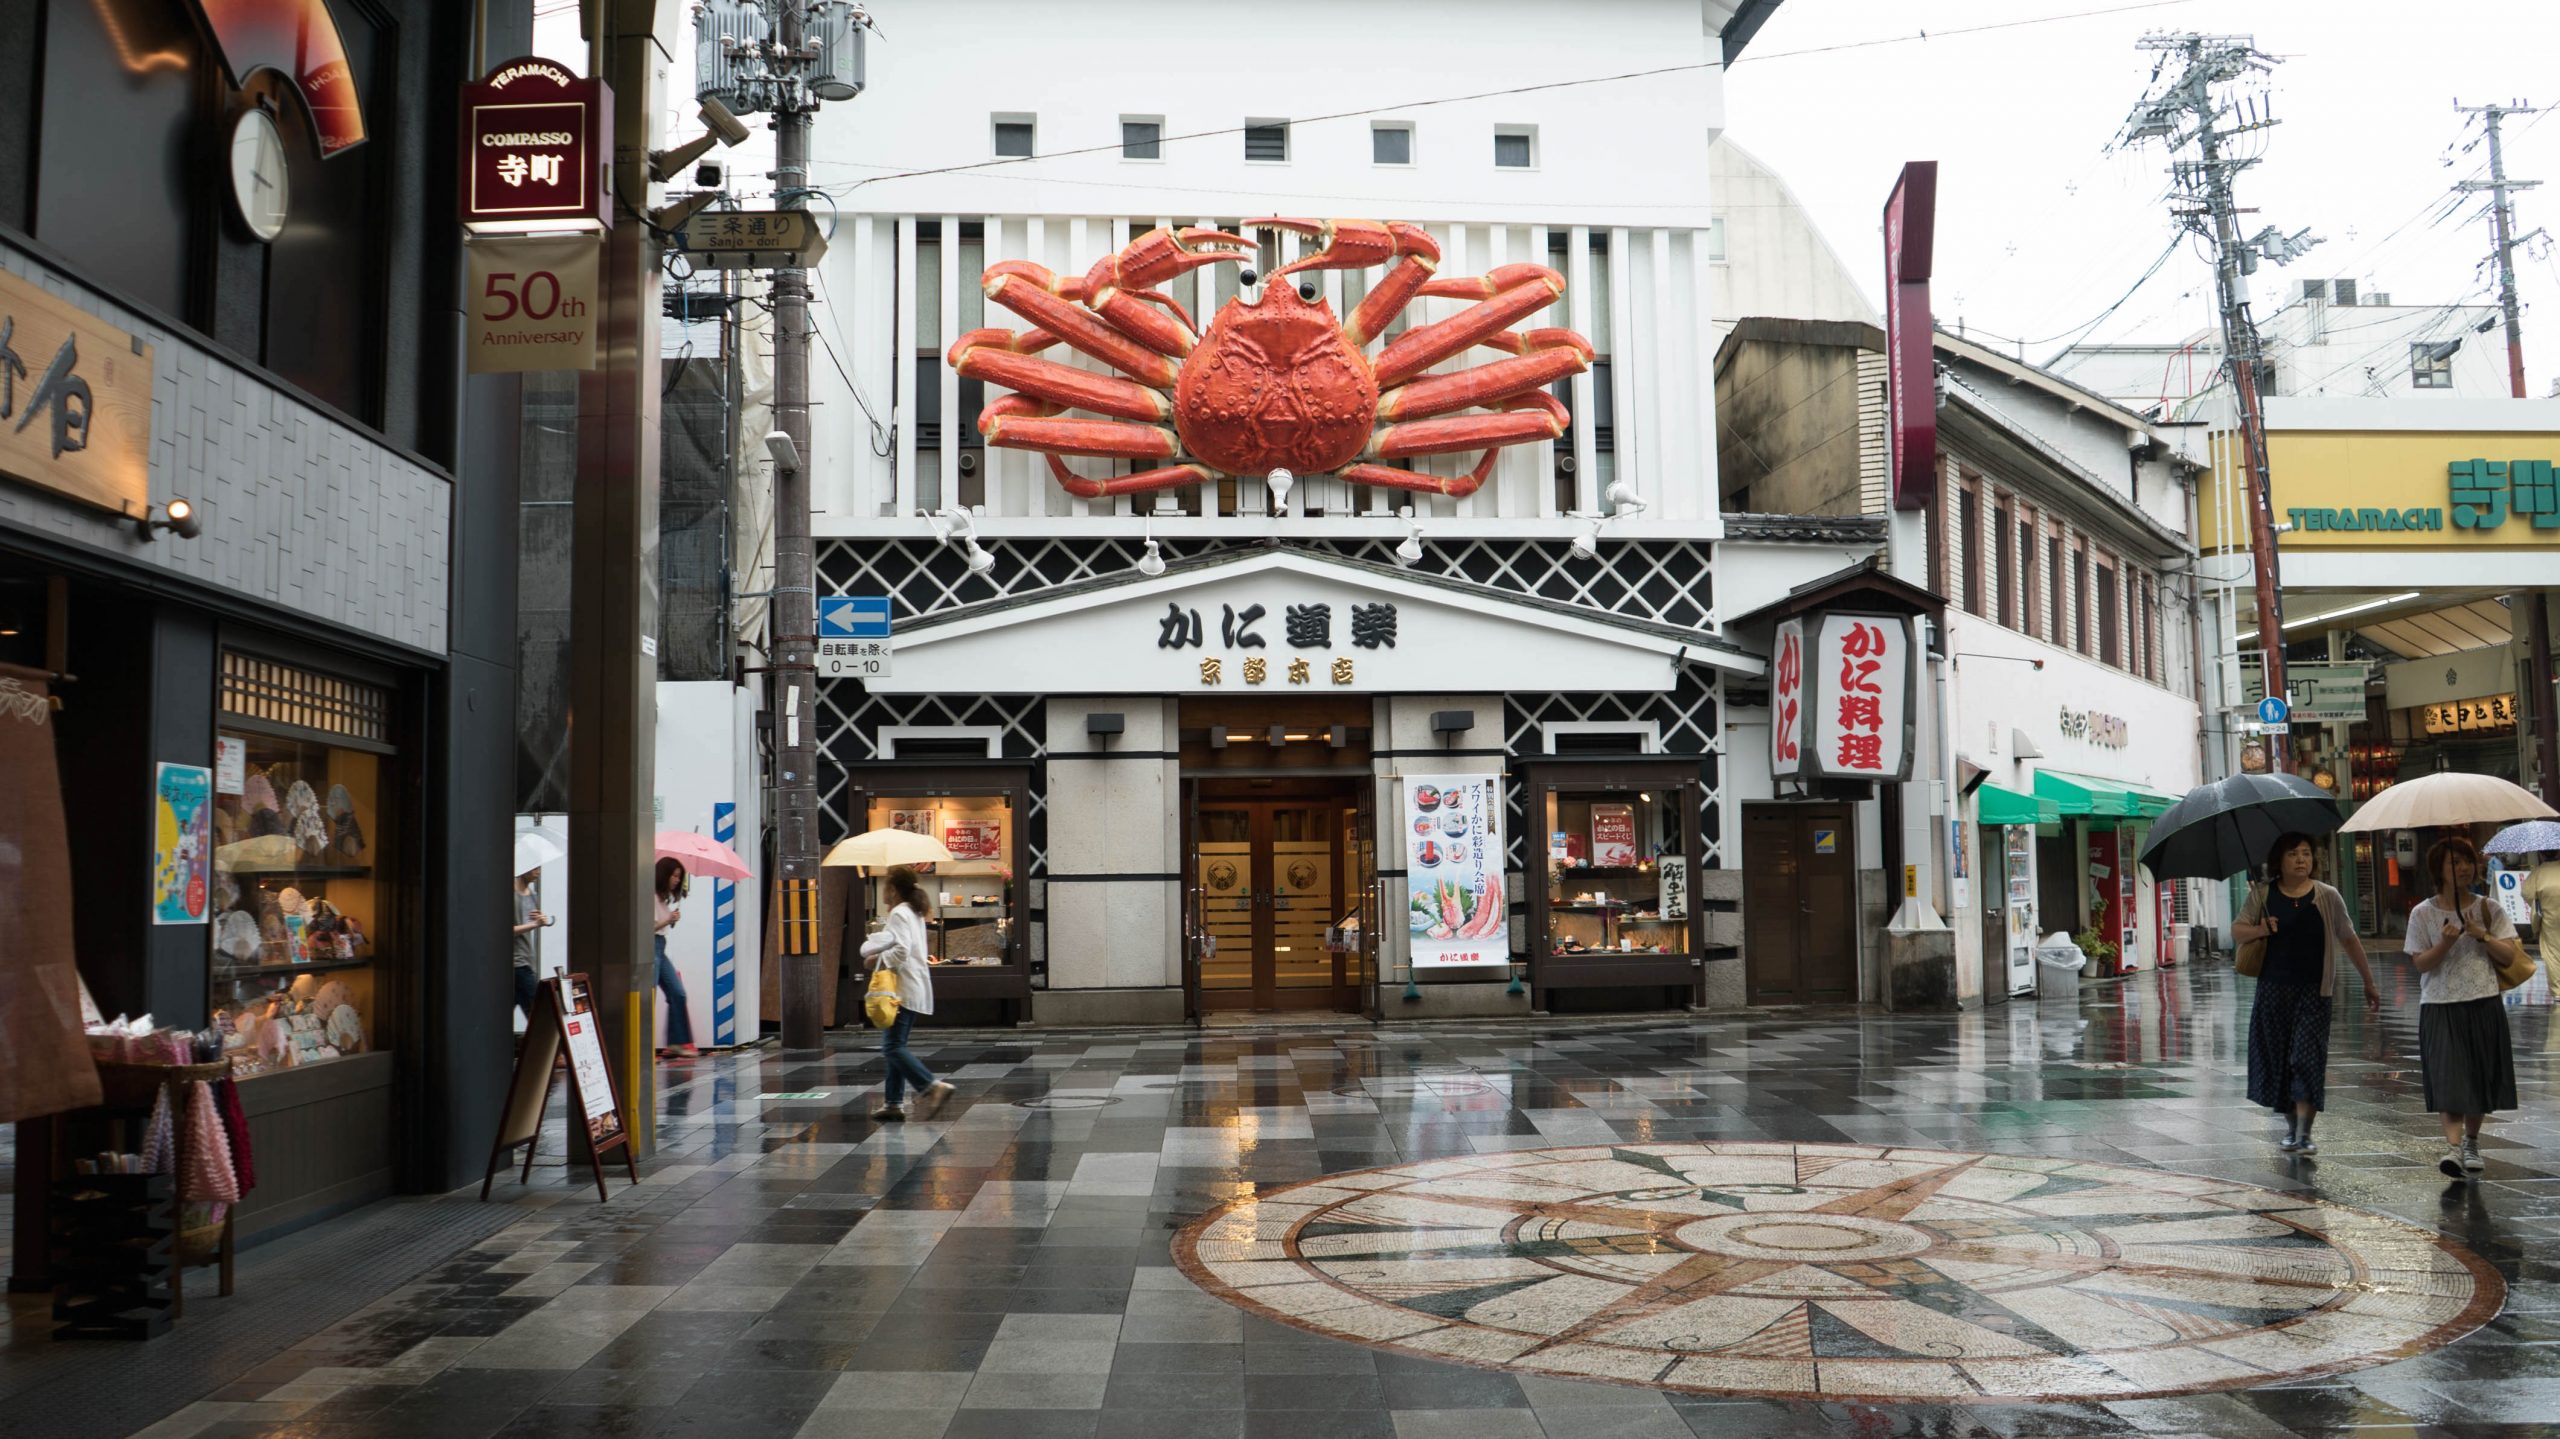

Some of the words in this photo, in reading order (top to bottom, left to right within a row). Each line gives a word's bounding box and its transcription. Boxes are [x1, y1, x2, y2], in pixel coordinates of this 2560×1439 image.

[490, 64, 570, 90] TERAMACHI
[482, 132, 573, 147] COMPASSO
[496, 153, 564, 187] 寺町
[698, 216, 791, 236] 三条通り
[482, 270, 586, 322] 50th
[482, 330, 584, 346] Anniversary
[2287, 507, 2443, 532] TERAMACHI
[1158, 602, 1398, 649] かに道楽
[823, 643, 889, 656] 自転車を除く
[1200, 655, 1354, 686] 京都本店
[1777, 631, 1800, 763] かに
[1837, 622, 1886, 770] かに料理
[1440, 952, 1480, 962] かに道楽
